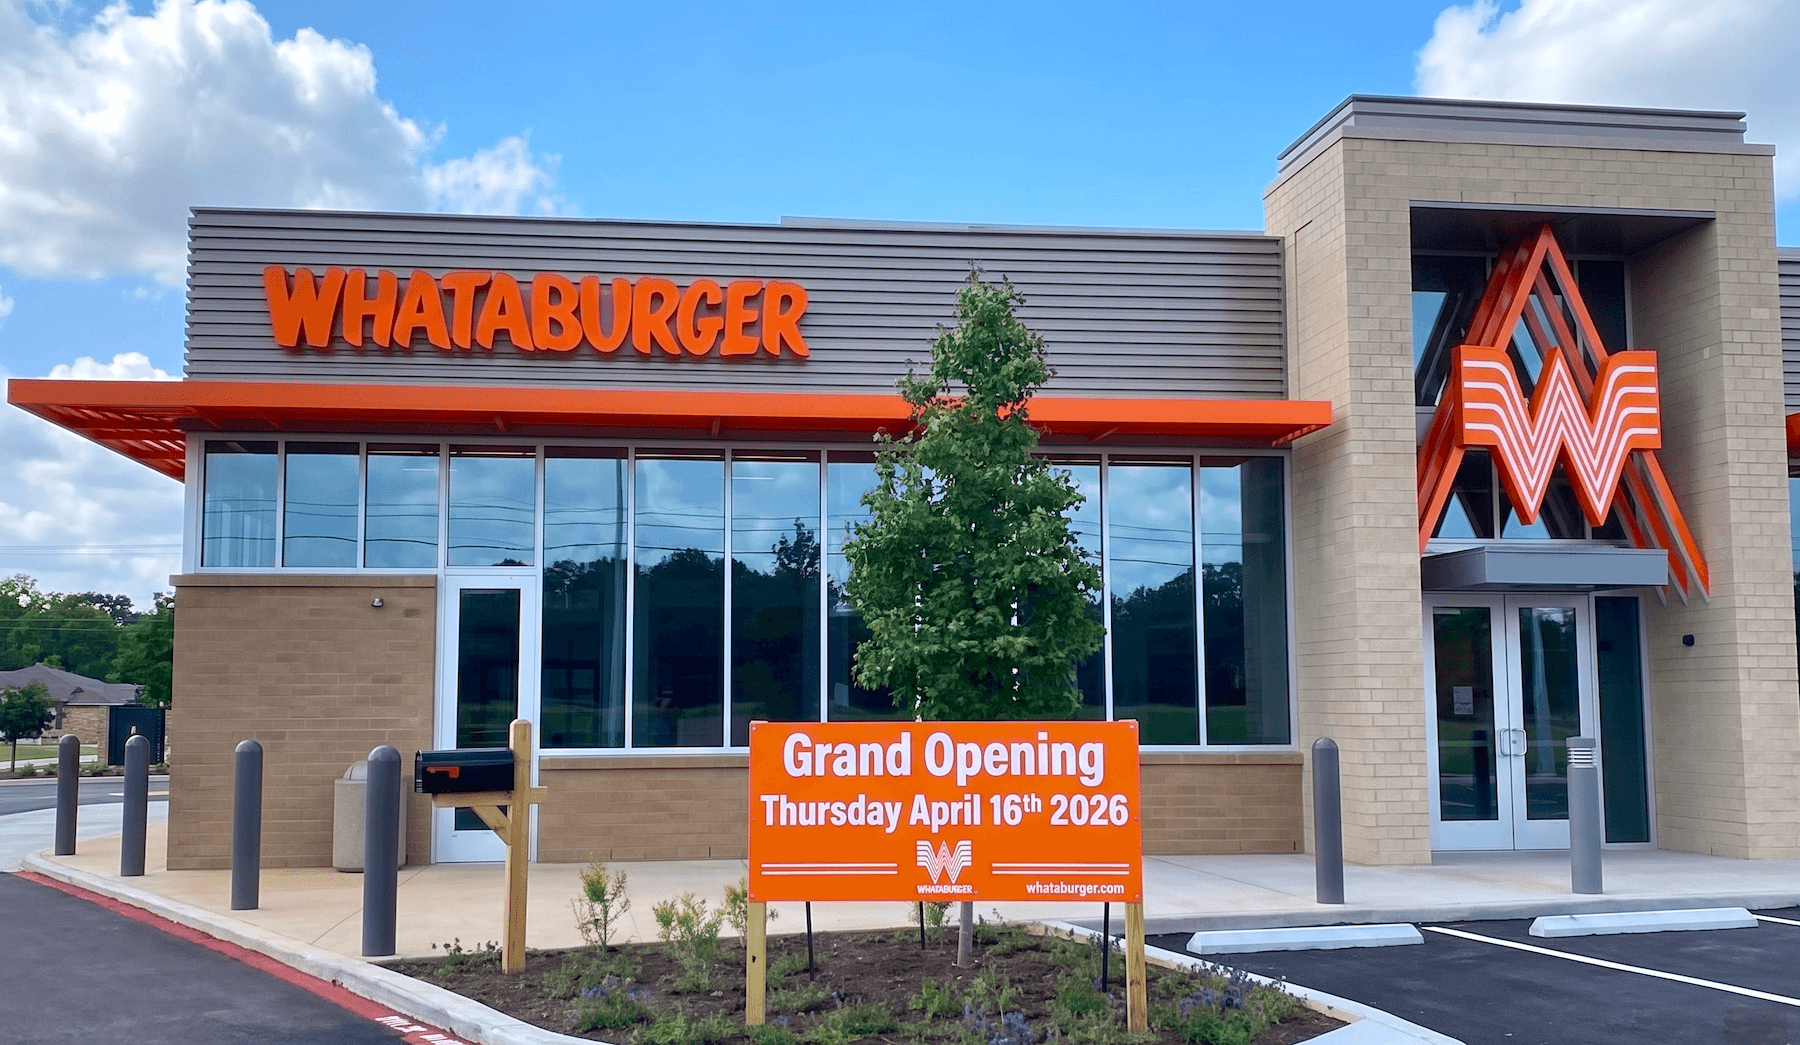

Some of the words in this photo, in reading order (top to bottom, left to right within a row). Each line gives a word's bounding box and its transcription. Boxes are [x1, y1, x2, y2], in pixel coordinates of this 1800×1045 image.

[262, 265, 811, 358] WHATABURGER
[783, 731, 911, 778] Grand
[924, 731, 1104, 787] Opening
[760, 794, 902, 834] Thursday
[909, 793, 981, 834] April
[989, 792, 1042, 826] 16th
[1050, 793, 1129, 826] 2026
[916, 884, 973, 894] WHATABURGER
[1026, 881, 1125, 897] whataburger.com
